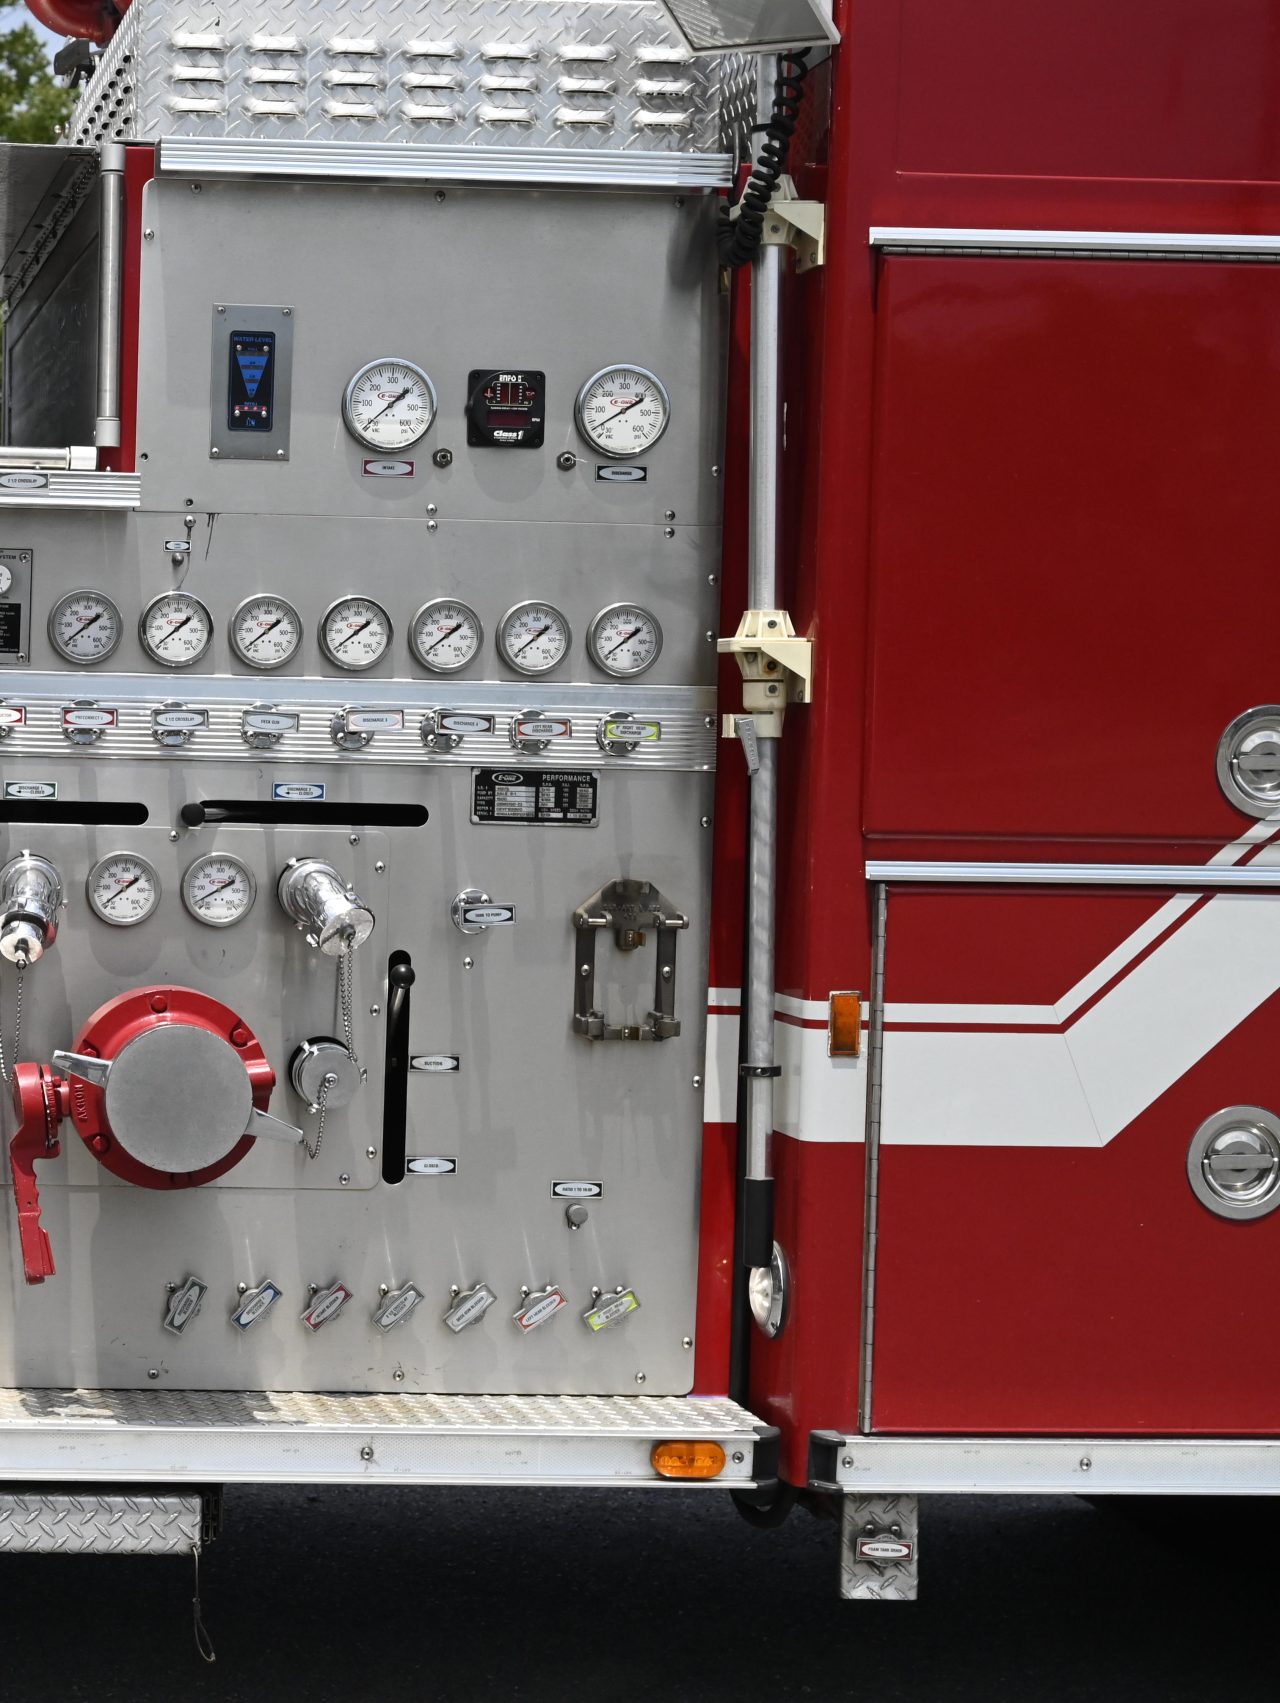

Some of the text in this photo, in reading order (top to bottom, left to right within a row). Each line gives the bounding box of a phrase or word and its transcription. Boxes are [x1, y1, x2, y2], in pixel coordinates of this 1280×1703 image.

[386, 376, 399, 384] 300
[618, 382, 631, 390] 300
[601, 390, 614, 398] 200
[362, 399, 373, 407] 100
[639, 409, 652, 417] 500
[399, 419, 412, 427] 600
[632, 425, 645, 433] 600
[542, 774, 591, 782] PERFORMANCE
[74, 1084, 88, 1119] AKRON
